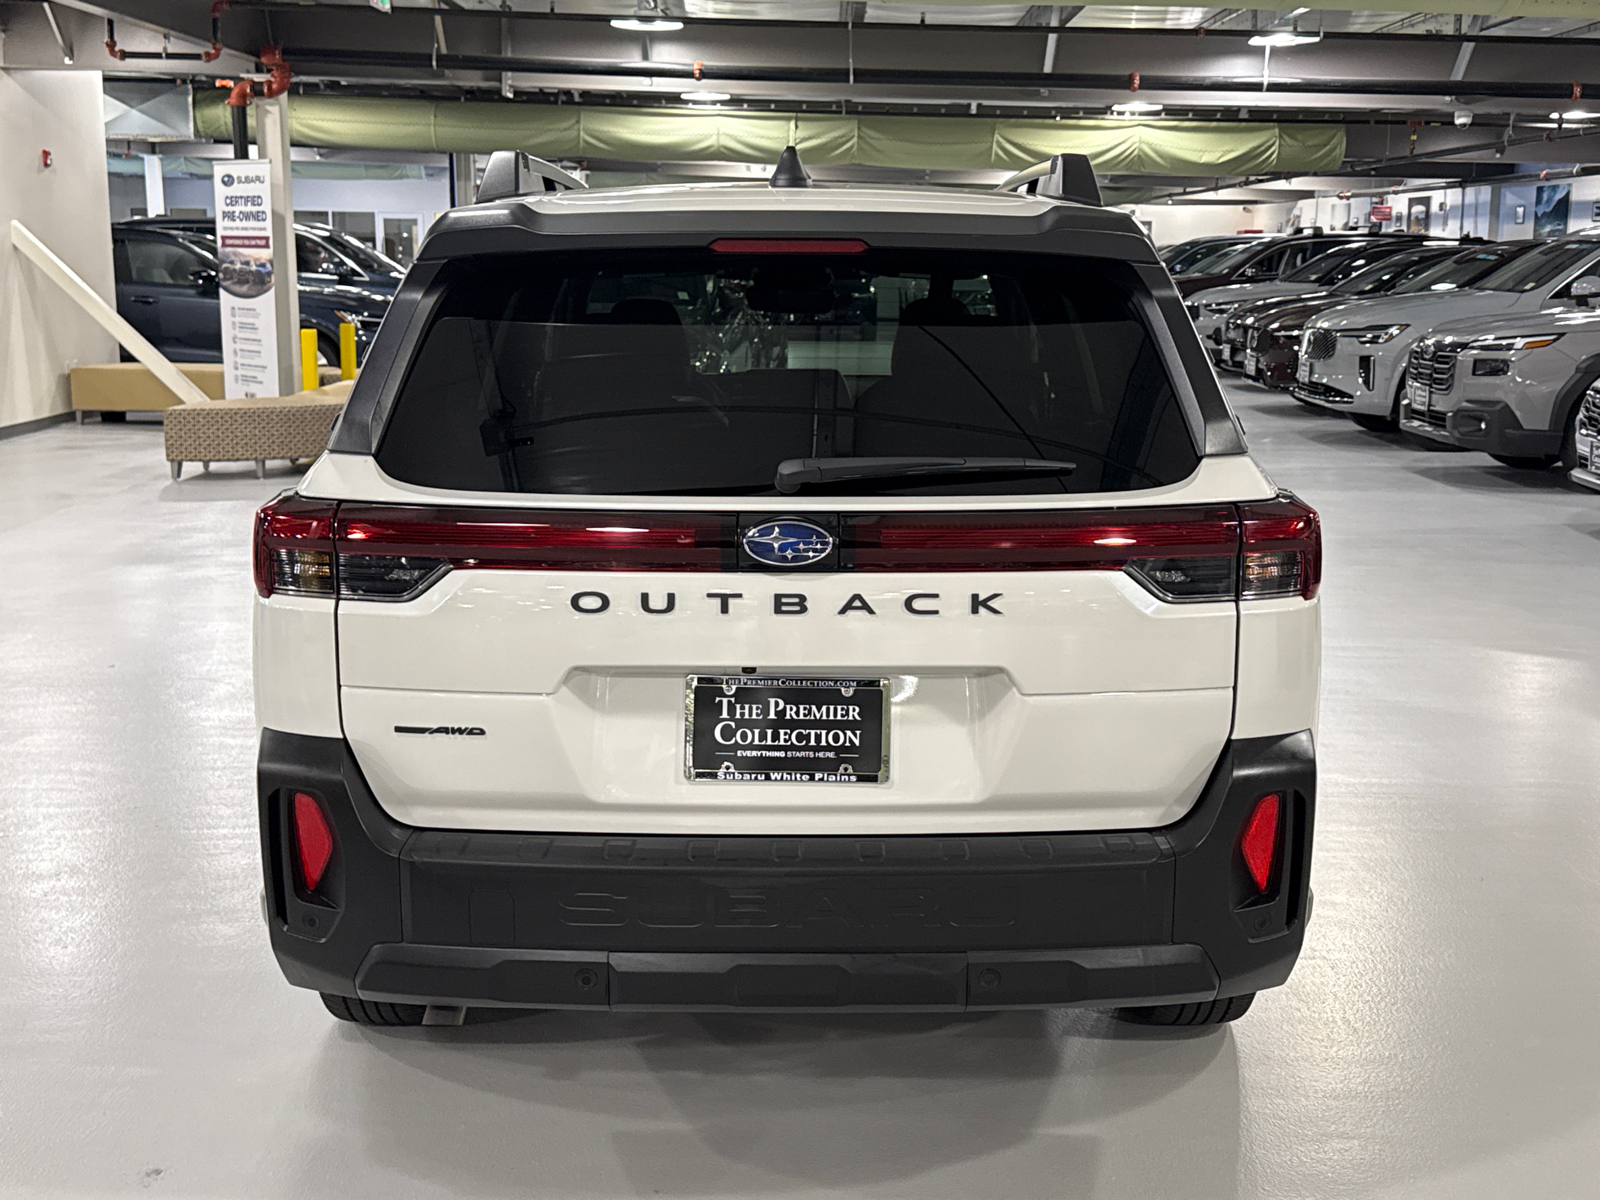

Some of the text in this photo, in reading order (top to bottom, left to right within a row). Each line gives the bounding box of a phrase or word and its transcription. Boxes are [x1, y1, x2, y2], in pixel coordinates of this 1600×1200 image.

[237, 175, 265, 184] SUBARU
[225, 195, 263, 207] CERTIFIED
[222, 210, 267, 222] PRE-OWNED
[570, 591, 1004, 615] OUTBACK
[715, 697, 861, 720] THE PREMIER
[428, 726, 486, 736] AWD
[714, 721, 861, 746] COLLECTION
[717, 771, 857, 782] Subaru White Plains
[558, 887, 1017, 929] SUBARU
